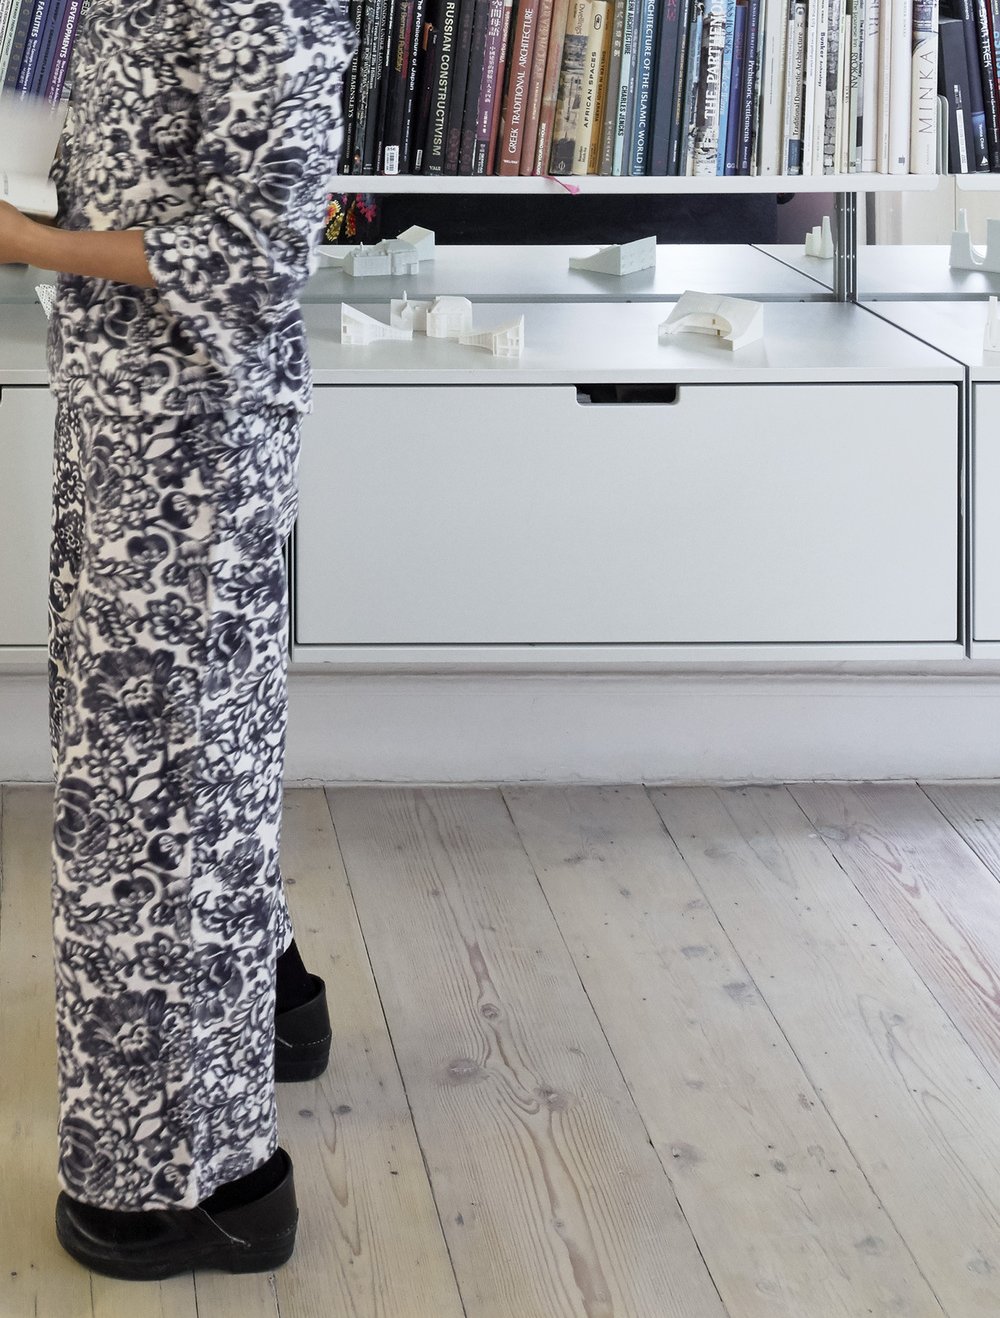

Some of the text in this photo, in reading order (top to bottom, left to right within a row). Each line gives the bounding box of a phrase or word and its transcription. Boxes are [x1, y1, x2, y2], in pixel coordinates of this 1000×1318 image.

[432, 2, 455, 156] RUSSIAN CONSTRUCTIVISM
[640, 72, 649, 88] THE
[641, 59, 649, 70] OF
[638, 91, 648, 127] ISLAMIC
[705, 91, 717, 119] THE
[918, 51, 934, 134] MINKA
[636, 130, 646, 163] WORLD
